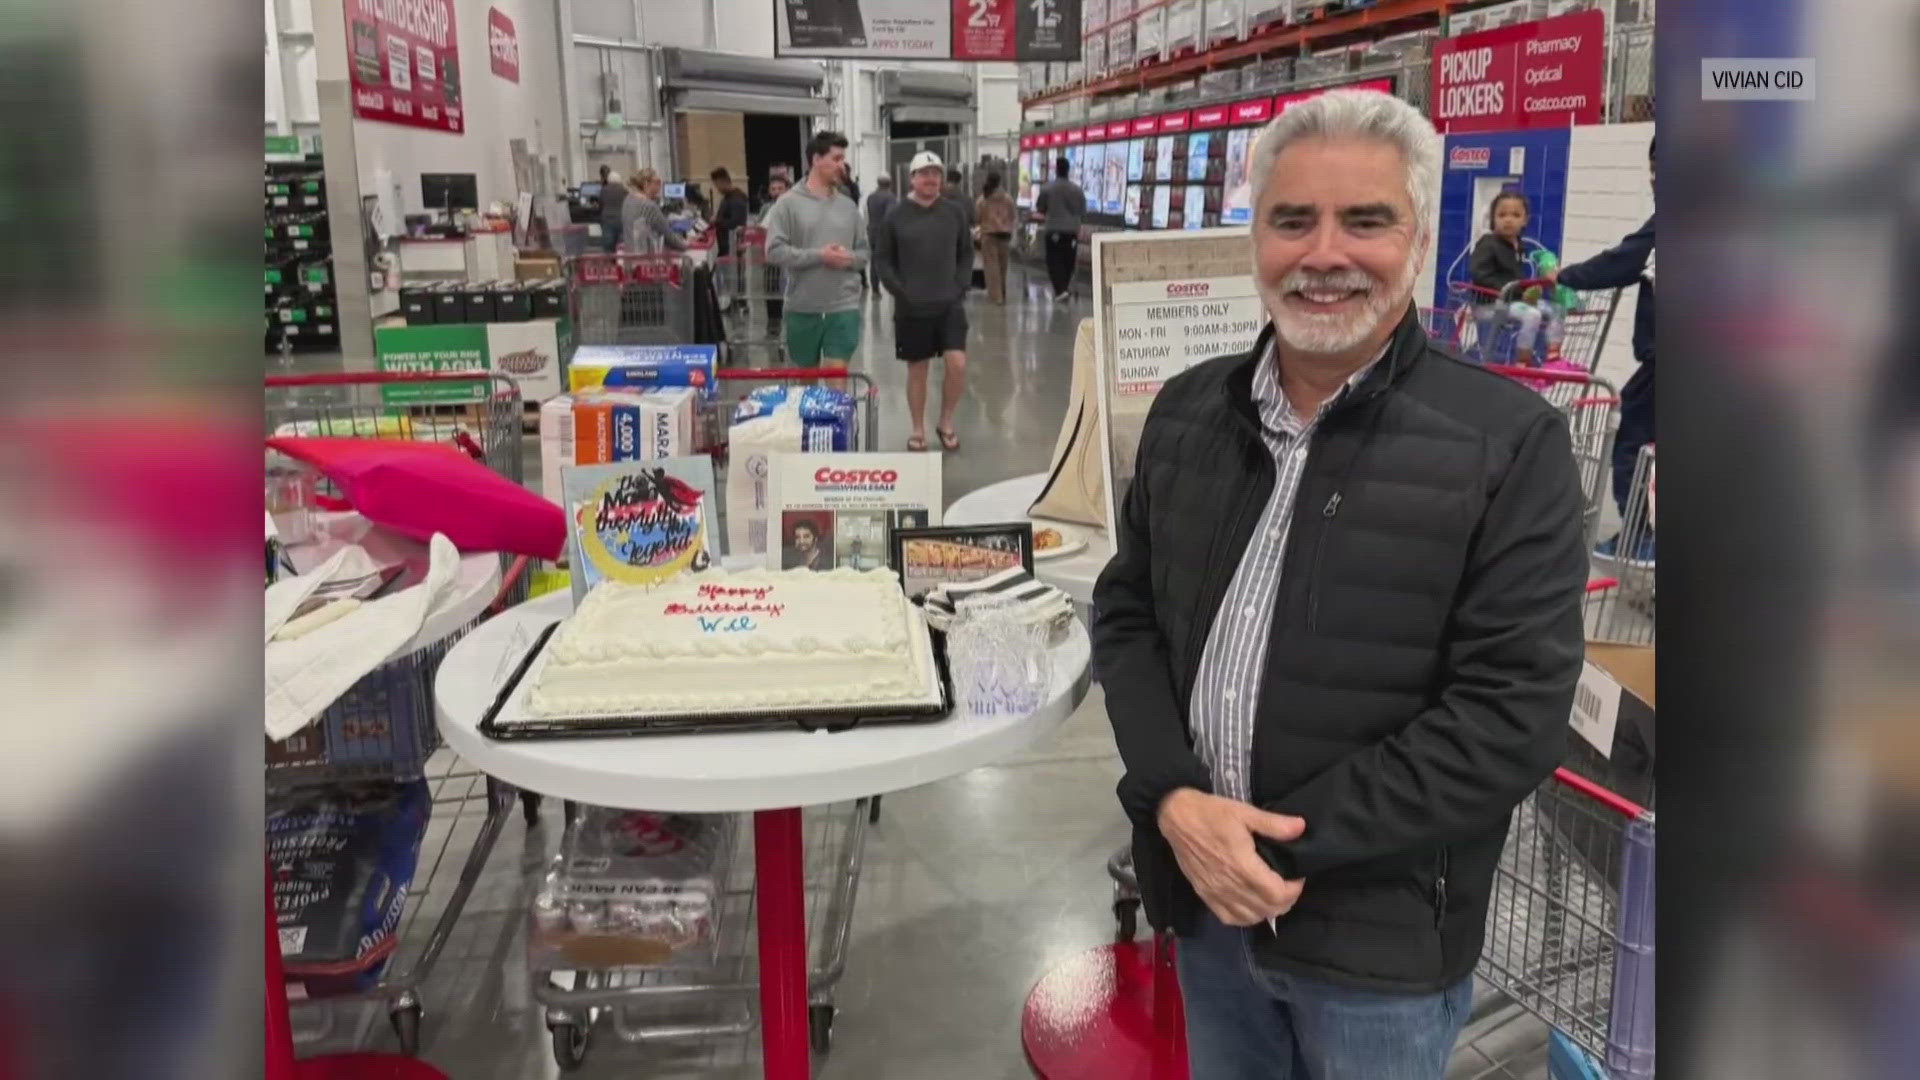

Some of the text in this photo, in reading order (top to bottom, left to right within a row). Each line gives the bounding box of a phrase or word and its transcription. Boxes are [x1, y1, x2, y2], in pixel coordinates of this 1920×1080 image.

[358, 0, 449, 49] MBERSHIP
[902, 39, 934, 50] TODAY
[1526, 36, 1582, 56] Pharmacy
[1441, 47, 1492, 84] PICKUP
[1525, 64, 1563, 87] Optical
[1439, 82, 1504, 118] LOCKERS
[1524, 95, 1587, 112] Costco.com
[1167, 283, 1209, 293] COSTCO
[1147, 303, 1229, 321] MEMBERS ONLY
[1119, 328, 1142, 341] MON
[1151, 327, 1166, 338] FRI
[1120, 346, 1171, 361] SATURDAY
[1120, 366, 1160, 380] SUNDAY
[619, 412, 634, 452] 4,000
[814, 467, 898, 484] COSTCO
[841, 484, 895, 492] WHOLESALE
